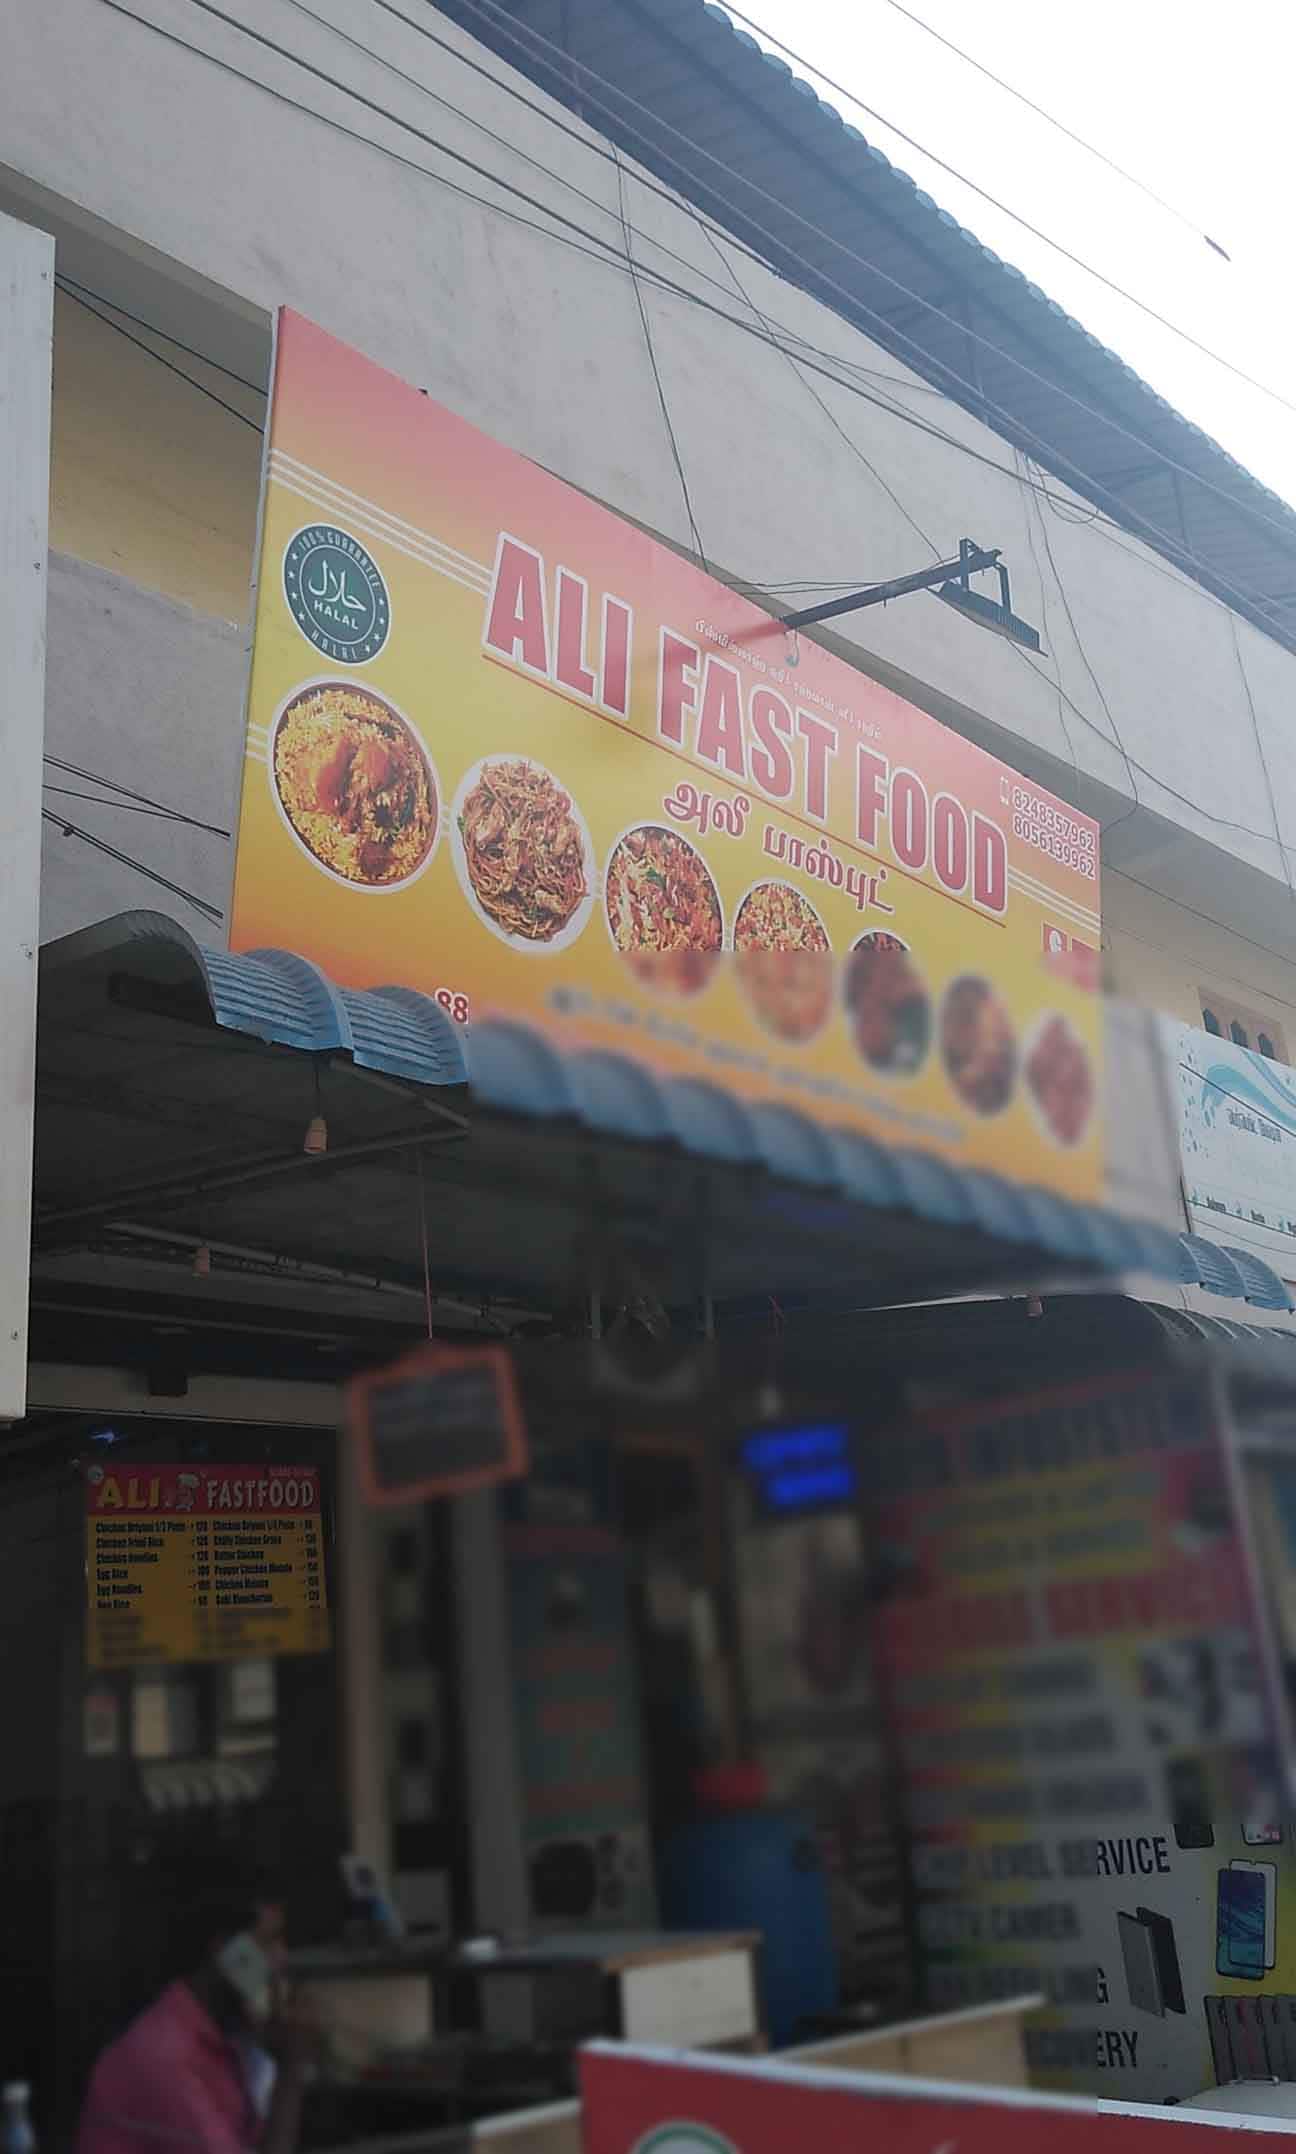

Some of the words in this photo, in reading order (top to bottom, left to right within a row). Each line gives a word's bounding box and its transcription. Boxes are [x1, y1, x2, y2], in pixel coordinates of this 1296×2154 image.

[308, 560, 367, 611] حلال
[314, 600, 359, 630] HALAL
[482, 531, 633, 720] ALI
[657, 625, 838, 823] FAST
[857, 741, 1008, 914] FOOD
[662, 782, 751, 840] அலீ
[762, 825, 896, 914] பாஸ்புட்
[96, 1476, 160, 1510] ALI
[206, 1479, 314, 1509] FASTFOOD
[1060, 1837, 1171, 1880] RVICE
